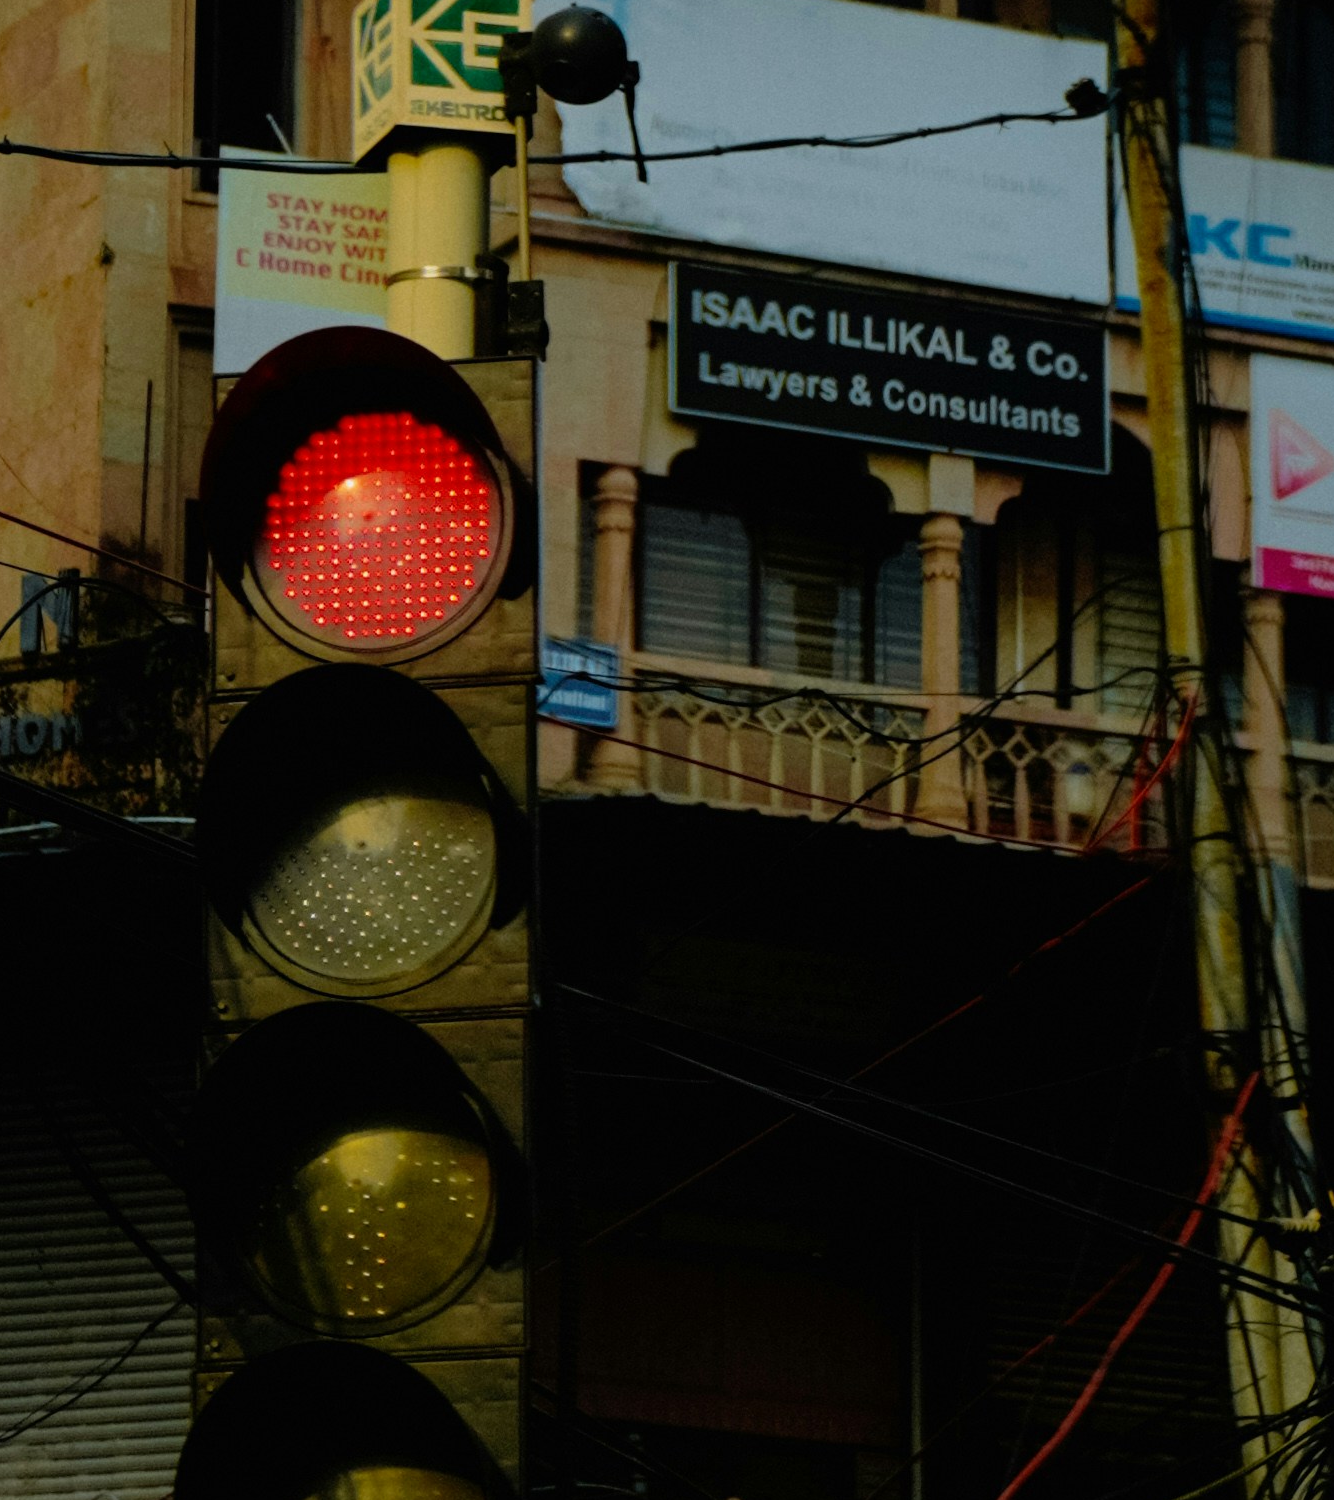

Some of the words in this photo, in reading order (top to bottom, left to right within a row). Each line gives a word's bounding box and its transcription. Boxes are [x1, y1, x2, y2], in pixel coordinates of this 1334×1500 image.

[426, 100, 506, 122] KELTRO
[267, 193, 323, 212] STAY
[331, 203, 387, 222] HOM
[279, 214, 334, 234] STAY
[342, 224, 385, 241] SAF
[263, 231, 335, 254] ENJOY
[344, 247, 387, 263] WIT
[258, 252, 332, 279] Home
[341, 263, 389, 288] Cin
[690, 289, 817, 342] ISAAC
[827, 308, 979, 367] ILLIKAL
[987, 334, 1017, 373] &
[1026, 340, 1089, 383] Co.
[698, 351, 839, 402] Lawyers
[848, 374, 872, 408] &
[882, 378, 1082, 438] Consultants
